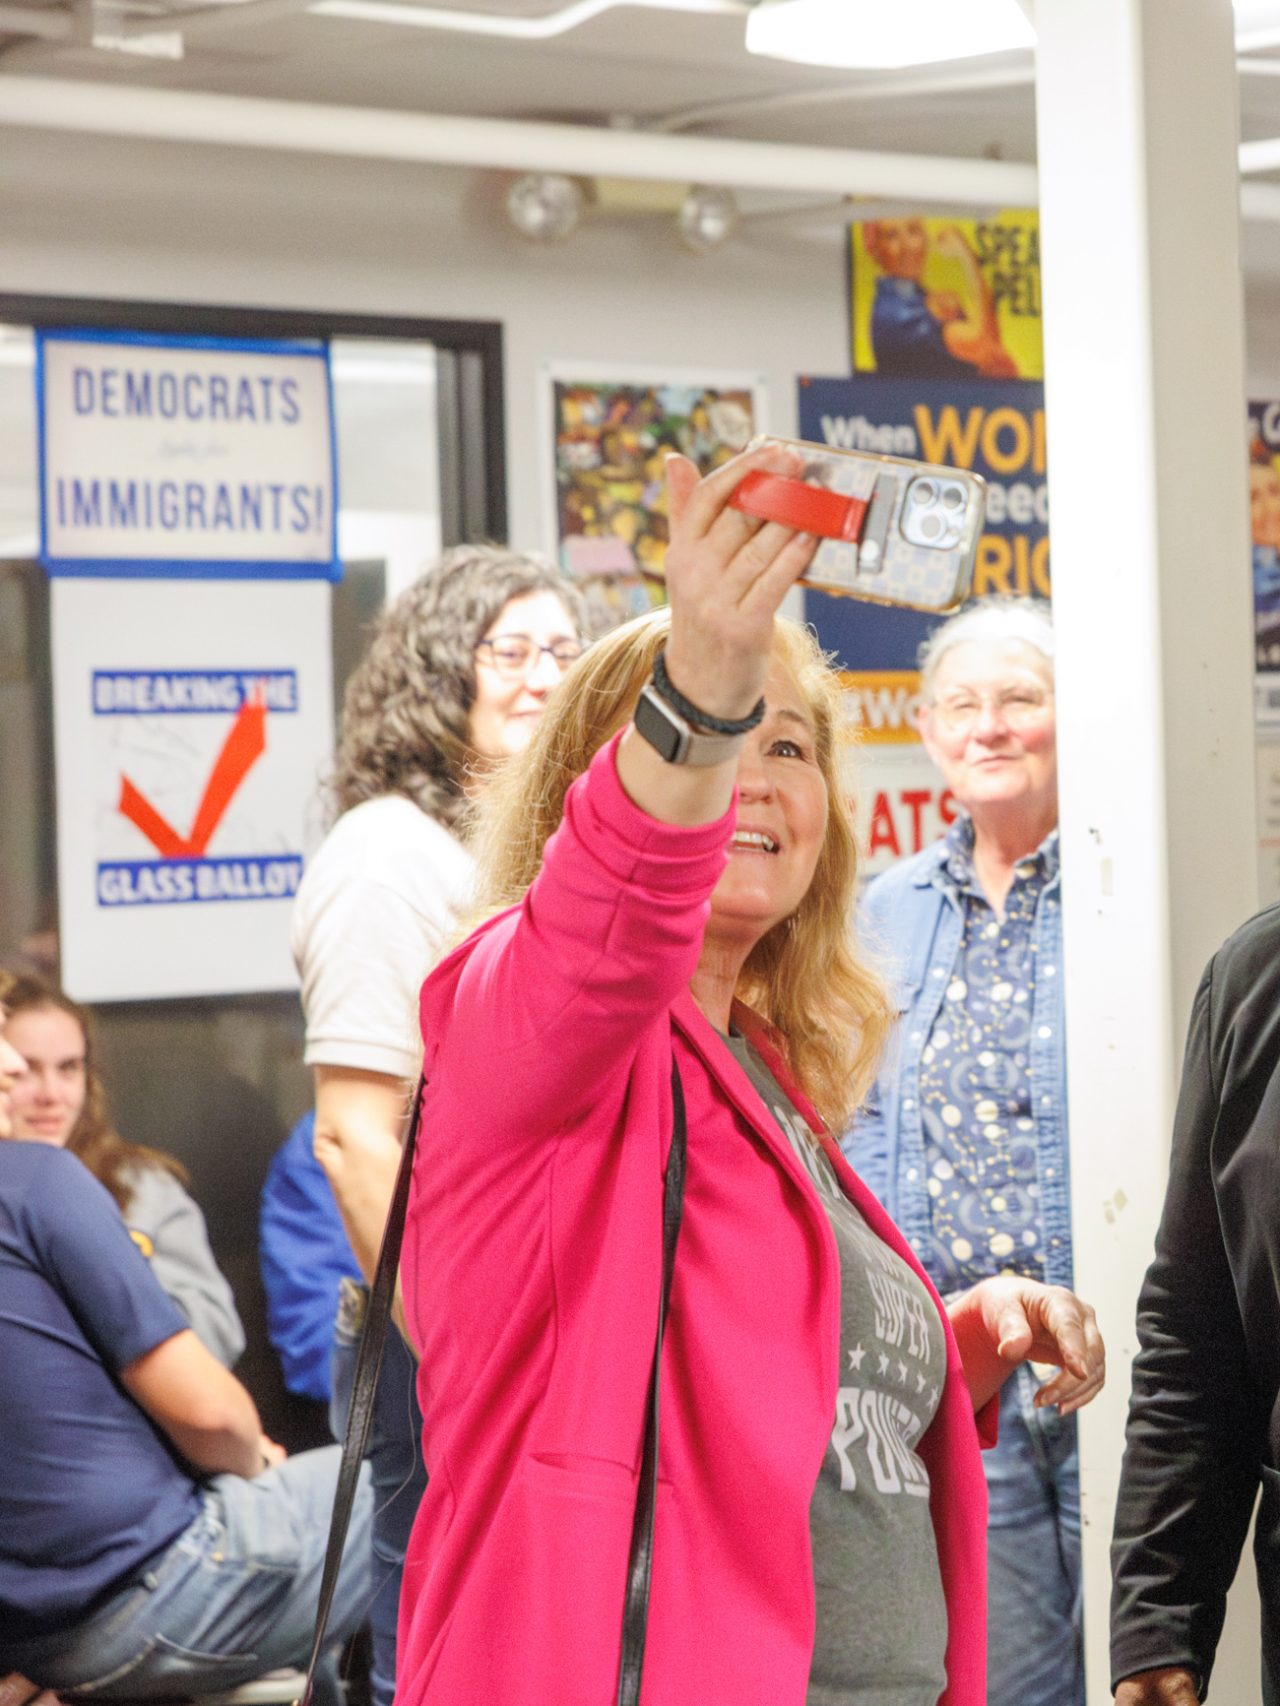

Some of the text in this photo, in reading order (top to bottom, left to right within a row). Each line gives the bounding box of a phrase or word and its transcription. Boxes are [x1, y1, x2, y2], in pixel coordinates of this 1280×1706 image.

[73, 367, 301, 424] DEMOCRATS
[821, 415, 917, 453] When
[56, 477, 324, 534] IMMIGRANTS!
[96, 674, 293, 708] BREAKING THE
[101, 861, 300, 902] GLASS BALLOT
